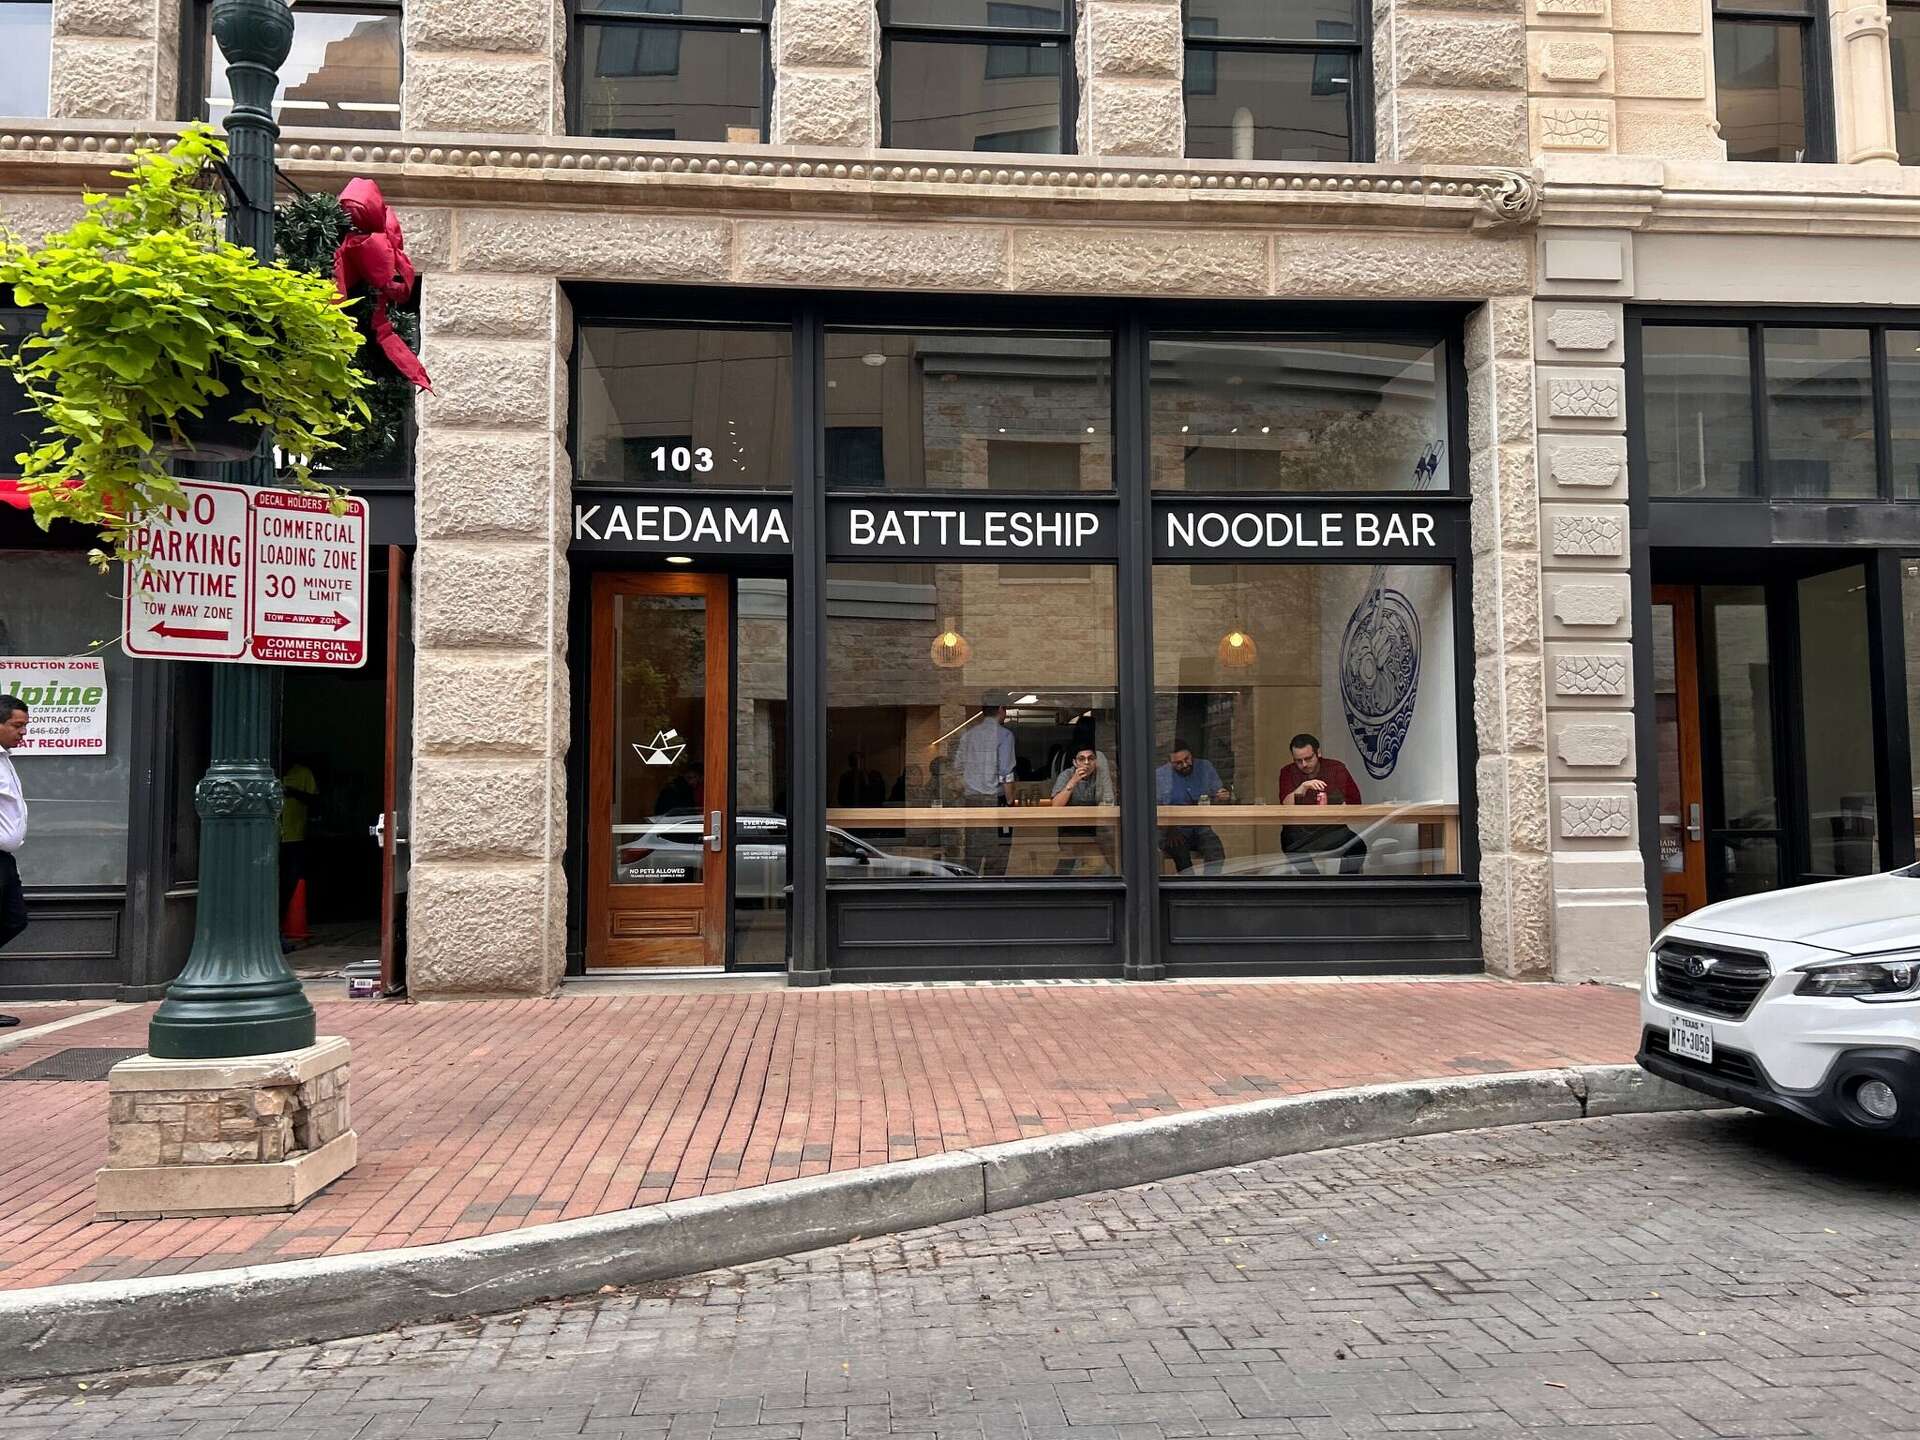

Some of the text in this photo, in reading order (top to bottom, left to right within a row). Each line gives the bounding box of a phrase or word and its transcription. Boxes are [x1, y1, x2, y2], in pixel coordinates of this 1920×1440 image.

[650, 446, 714, 472] 103
[259, 494, 285, 507] DECAL
[287, 497, 323, 511] HOLDERS
[263, 516, 356, 544] COMMERCIAL
[575, 504, 1436, 548] KAEDAMA BATTLESHIP NOODLE BAR
[138, 528, 241, 568] PARKING
[260, 544, 358, 571] LOADING ZONE
[141, 569, 237, 599] ANYTIME
[264, 574, 296, 599] 30
[303, 577, 353, 591] MINUTE
[309, 590, 342, 602] LIMIT
[143, 601, 233, 620] TOW AWAY ZONE
[319, 616, 343, 625] ZONE
[266, 638, 349, 652] COMMERCIAL
[257, 648, 358, 662] VEHICLES ONLY
[68, 662, 100, 670] ZONE
[0, 680, 104, 706] lpine
[39, 739, 103, 748] REQUIRED
[1681, 1018, 1699, 1030] TEXAS
